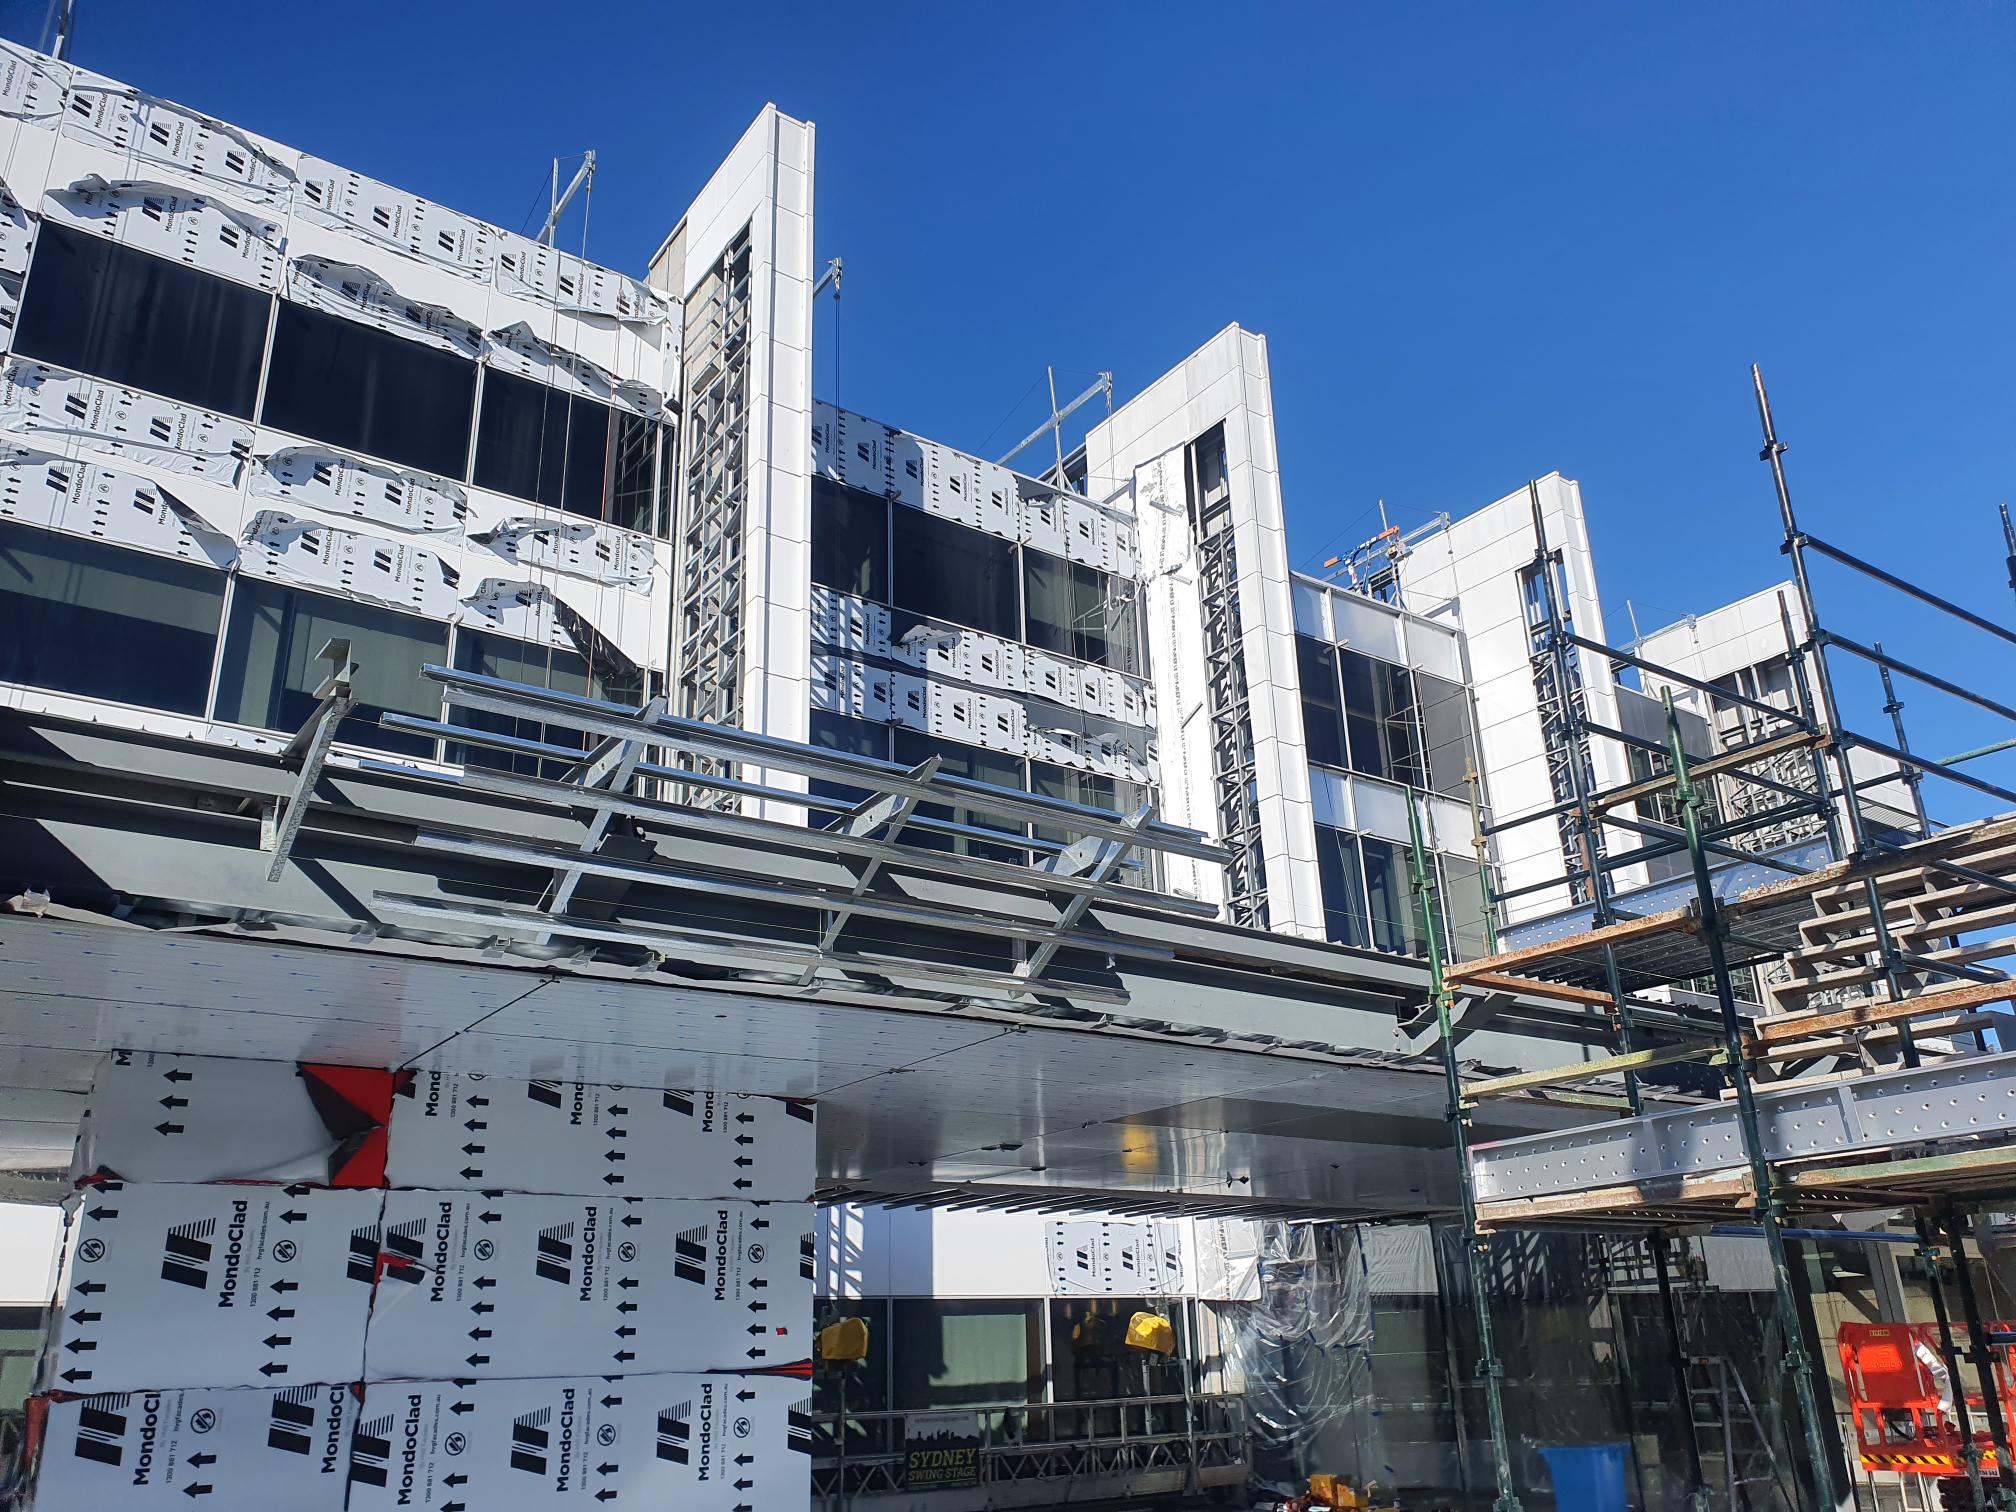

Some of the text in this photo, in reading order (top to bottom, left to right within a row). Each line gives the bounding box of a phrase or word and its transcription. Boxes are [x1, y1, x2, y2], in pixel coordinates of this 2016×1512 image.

[2, 60, 17, 96] MondoClad
[172, 121, 185, 156] MondoClad
[165, 196, 178, 232] MondoClad
[393, 205, 402, 237] MondoClad
[457, 228, 466, 262] MondoClad
[90, 390, 104, 430] MondoClad
[72, 463, 87, 504] MondoClad
[323, 525, 334, 565] MondoClad
[396, 544, 405, 583] MondoClad
[218, 1200, 248, 1308] MondoClad
[430, 1202, 452, 1302] MondoClad
[580, 1206, 597, 1301] MondoClad
[714, 1210, 728, 1301] MondoClad
[397, 1394, 422, 1505] MondoClad
[556, 1388, 575, 1492] MondoClad
[698, 1383, 712, 1481] MondoClad
[908, 1466, 977, 1481] SWING STAGE
[909, 1448, 977, 1469] SYDNEY
